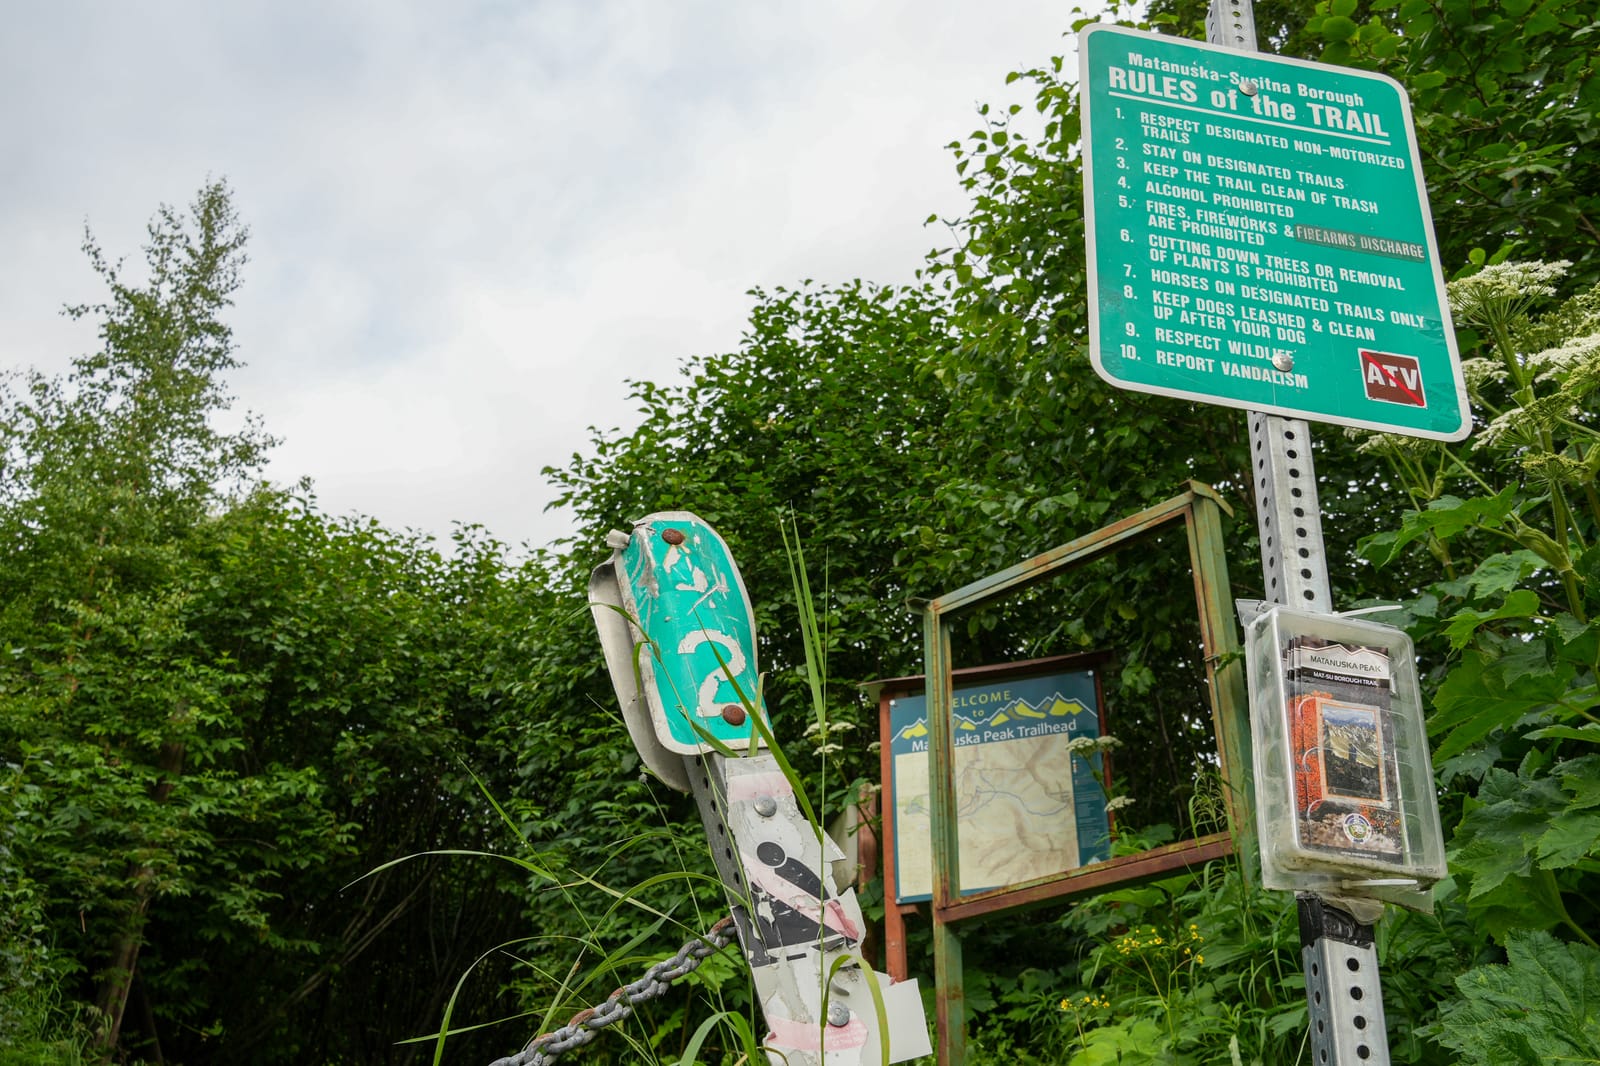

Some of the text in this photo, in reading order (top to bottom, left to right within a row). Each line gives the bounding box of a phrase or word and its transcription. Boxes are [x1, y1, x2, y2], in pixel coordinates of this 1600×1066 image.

[1108, 66, 1389, 137] RULES of the TRAIL
[1128, 52, 1364, 107] Matanuska-Susitna Borough
[1115, 107, 1406, 170] 1. RESPECT DESIGNATED NON-MOTORIZED
[1141, 124, 1190, 144] TRAILS
[1115, 138, 1345, 190] 2. STAY ON DESIGNATED TRAILS
[1116, 156, 1379, 214] 3. KEEP THE TRAIL CLEAN OF TRASH
[1117, 175, 1295, 218] 4. ALCOHOL PROHIBITED
[1118, 194, 1132, 208] 5.
[1196, 208, 1278, 235] FIREWORKS
[1284, 224, 1295, 238] &
[1296, 226, 1356, 248] FIREARMS
[1360, 236, 1425, 259] DISCHARGE
[1148, 214, 1265, 246] ARE PROHIBITED
[1120, 228, 1405, 291] 6. CUTTING DOWN TREES OR REMOVAL
[1149, 248, 1339, 293] OF PLANTS IS PROHIBITED
[1123, 263, 1425, 329] 7. HORSES ON DESIGNATED TRAILS ONLY
[1123, 285, 1376, 341] 8. KEEP DOGS LEASHED & CLEAN
[1125, 322, 1140, 338] 9.
[1155, 327, 1221, 351] RESPECT
[1153, 305, 1307, 344] UP AFTER YOUR DOG
[1120, 343, 1309, 389] 10. REPORT VANDALISM
[1367, 362, 1418, 391] ATV
[677, 629, 754, 717] 2
[1310, 655, 1382, 673] MATANUSKA PEAK
[1334, 675, 1363, 684] BOROUGH
[952, 689, 1012, 708] ELCOME
[972, 708, 985, 717] to
[911, 719, 1077, 752] Mauska Peak Trailhead
